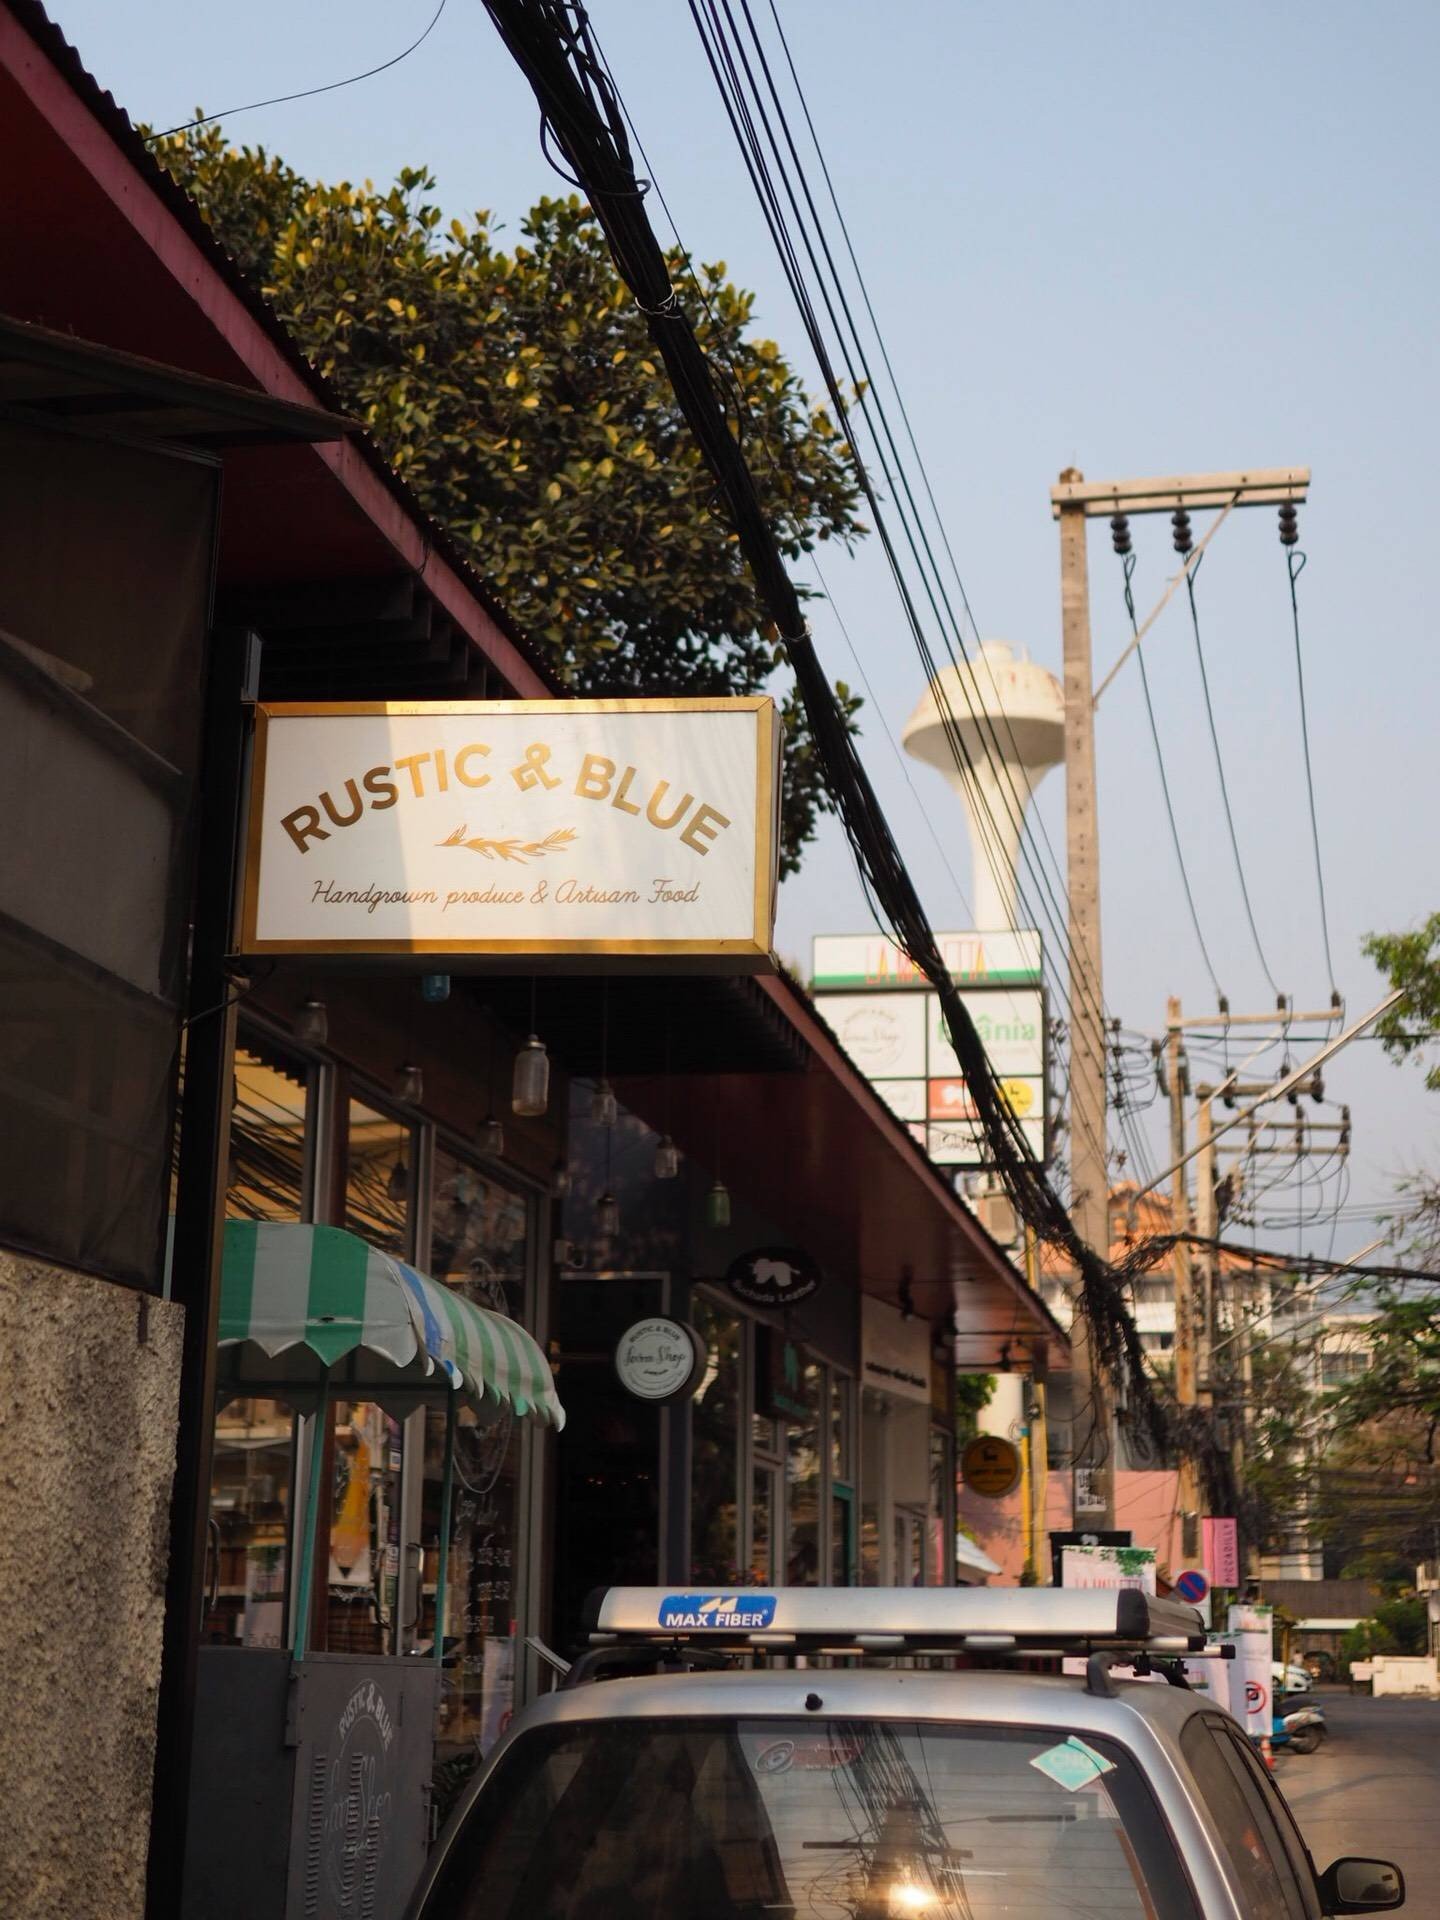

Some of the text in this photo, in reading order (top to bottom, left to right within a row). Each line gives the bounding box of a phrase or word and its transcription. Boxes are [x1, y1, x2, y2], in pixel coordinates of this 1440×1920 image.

[280, 742, 732, 857] RUSTIC & BLUE
[312, 878, 701, 914] Handgrown produce & Artisan Food
[665, 1613, 763, 1627] MAX FIBER
[375, 1696, 393, 1753] BLUE
